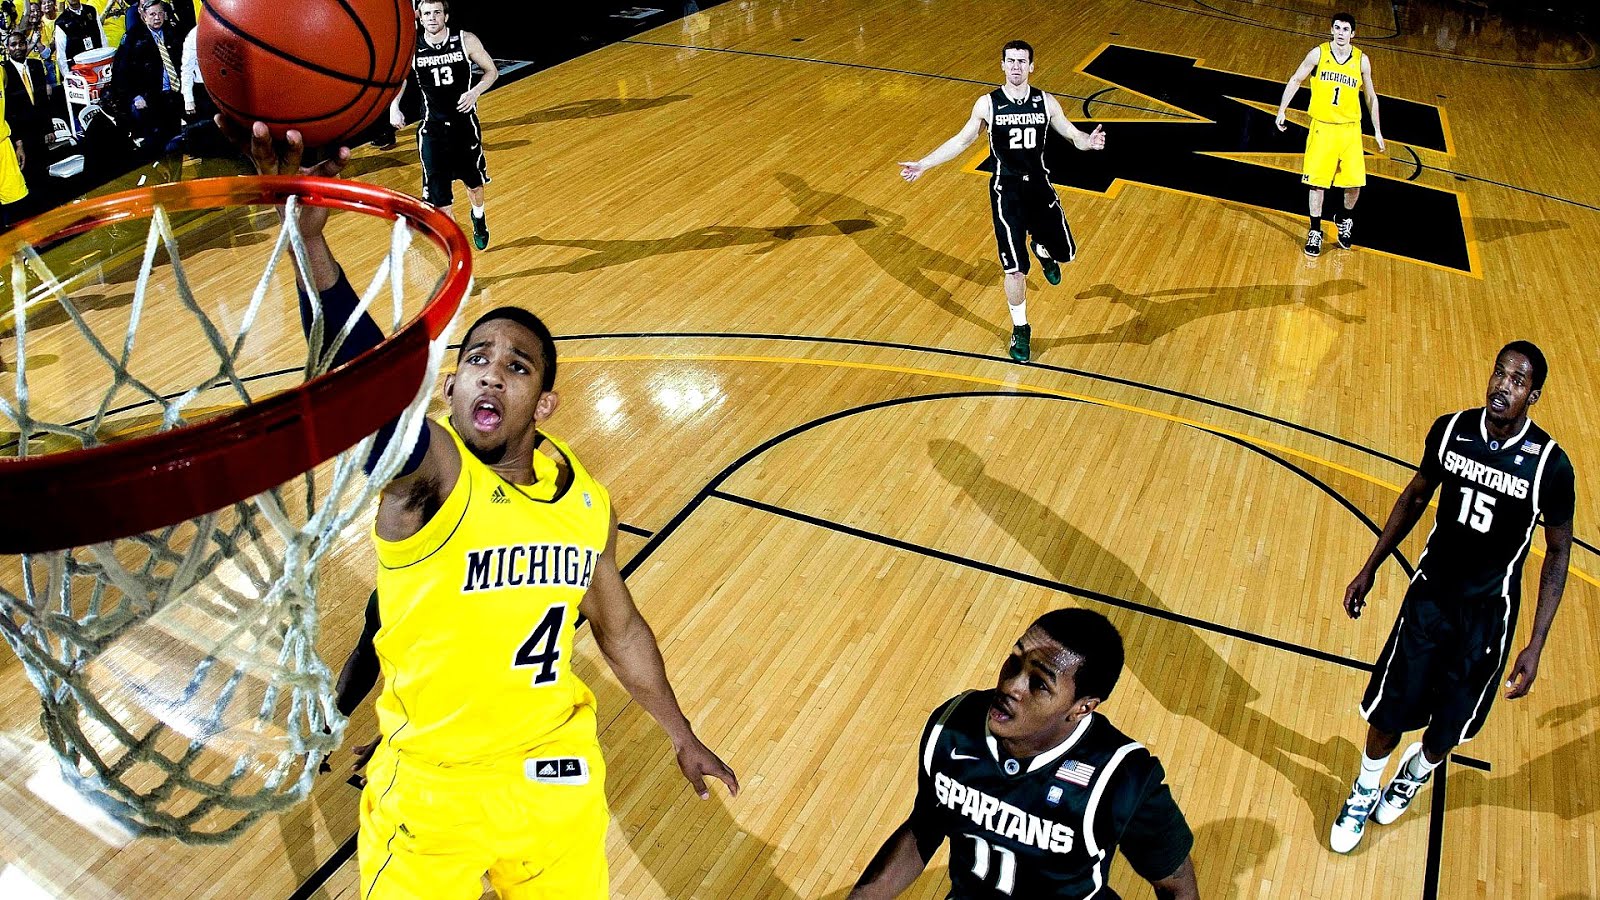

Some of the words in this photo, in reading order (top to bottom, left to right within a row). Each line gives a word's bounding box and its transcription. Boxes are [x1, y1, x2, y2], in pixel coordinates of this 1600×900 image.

[416, 50, 464, 68] SPARTANS
[430, 65, 455, 87] 13
[1320, 71, 1358, 88] MICHIGAN
[1331, 86, 1341, 106] 1
[995, 112, 1046, 126] SPARTANS
[1008, 127, 1037, 150] 20
[1443, 450, 1530, 500] SPARTANS
[1456, 486, 1497, 534] 15
[462, 543, 600, 592] MICHIGA
[513, 604, 566, 686] 4
[934, 771, 1075, 855] SPARTANS
[963, 832, 1017, 896] 11
